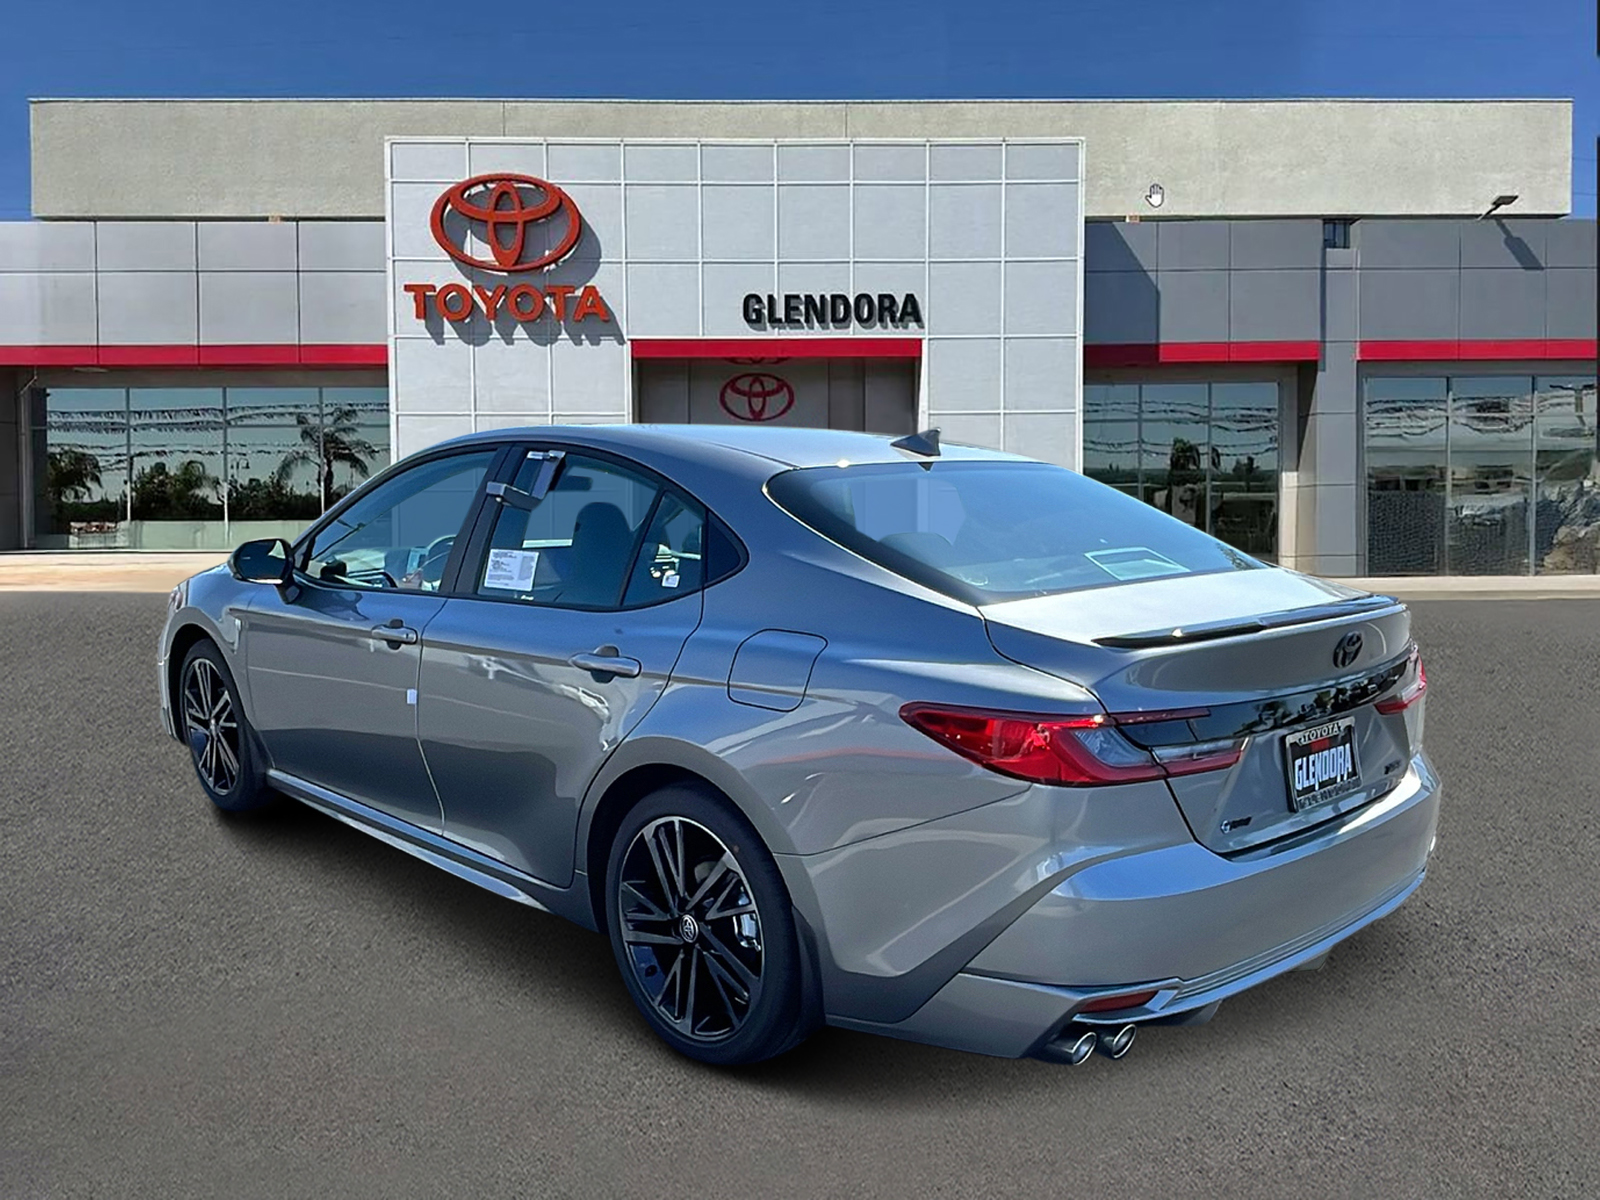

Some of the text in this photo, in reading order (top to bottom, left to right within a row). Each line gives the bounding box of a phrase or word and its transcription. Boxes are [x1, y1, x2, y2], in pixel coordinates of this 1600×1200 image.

[403, 283, 610, 323] TOYOTA
[743, 293, 924, 326] GLENDORA
[1304, 723, 1340, 743] TOYOTA
[1294, 742, 1352, 791] GLENDORA
